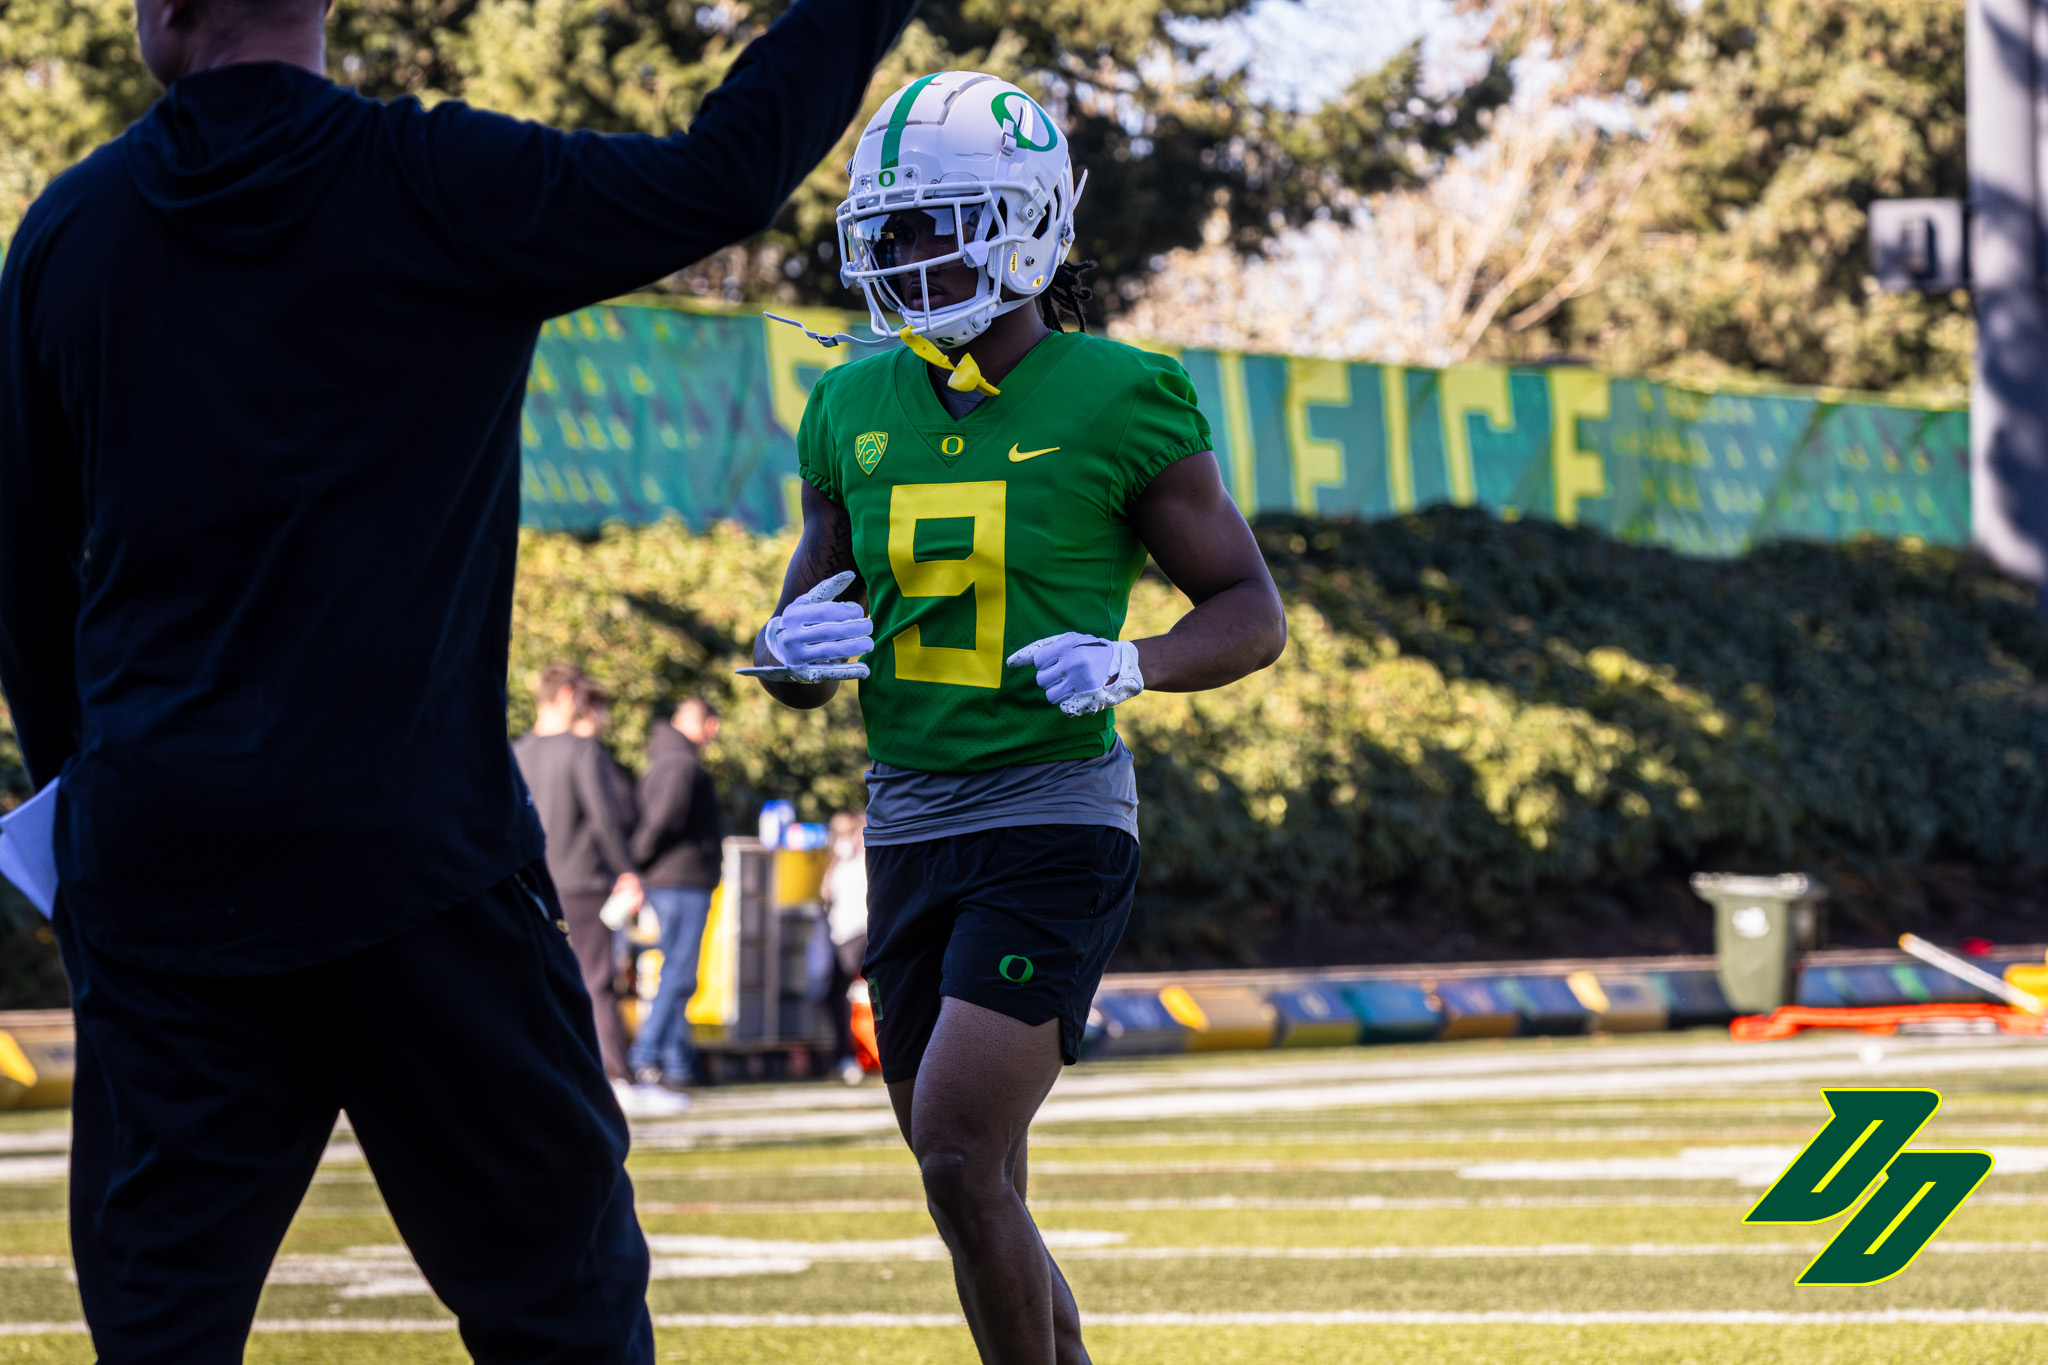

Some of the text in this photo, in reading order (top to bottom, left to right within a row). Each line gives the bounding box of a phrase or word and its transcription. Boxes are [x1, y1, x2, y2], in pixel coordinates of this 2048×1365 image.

[878, 170, 896, 188] O
[857, 432, 886, 459] PAC
[862, 448, 877, 466] 12
[941, 435, 965, 456] O
[888, 480, 1007, 689] 9
[999, 954, 1034, 984] O
